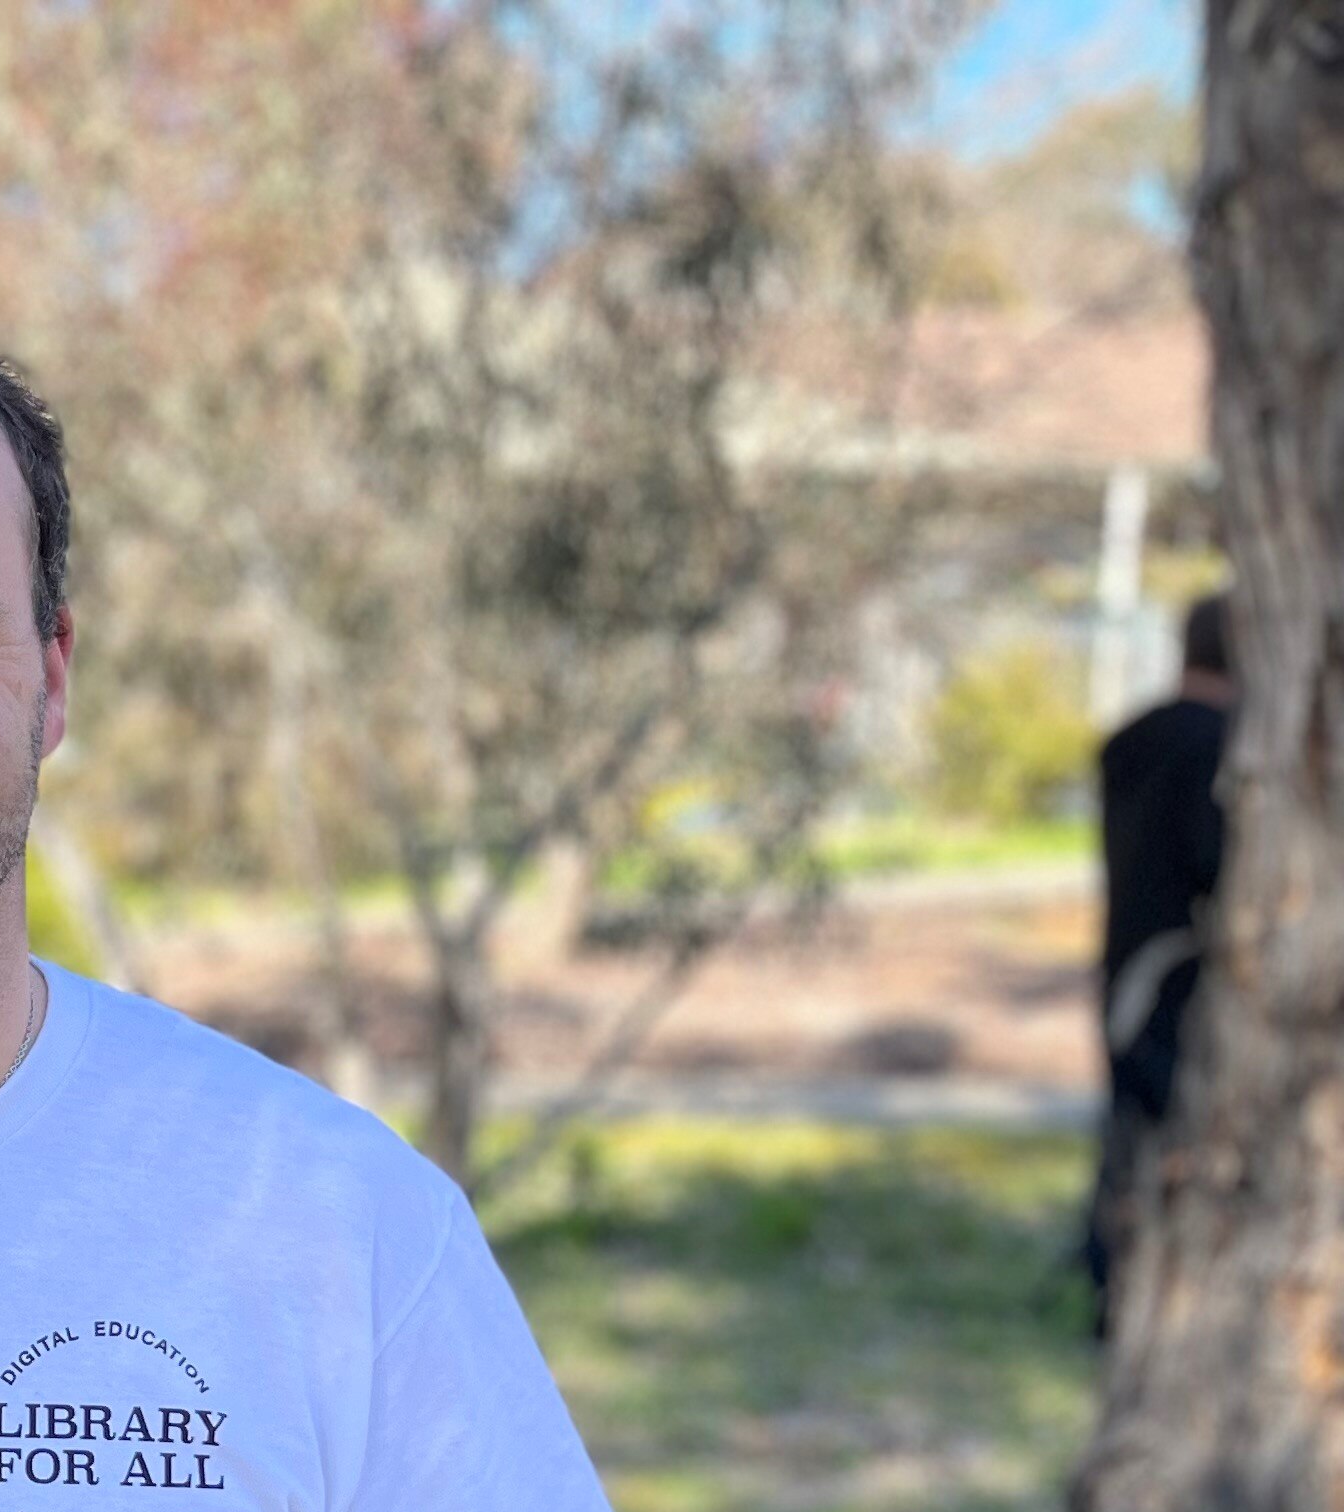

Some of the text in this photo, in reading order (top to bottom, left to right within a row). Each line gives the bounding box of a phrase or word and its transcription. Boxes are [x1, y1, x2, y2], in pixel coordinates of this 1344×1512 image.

[0, 1321, 209, 1393] DIGITAL EDUCATION
[120, 1452, 224, 1489] ALL
